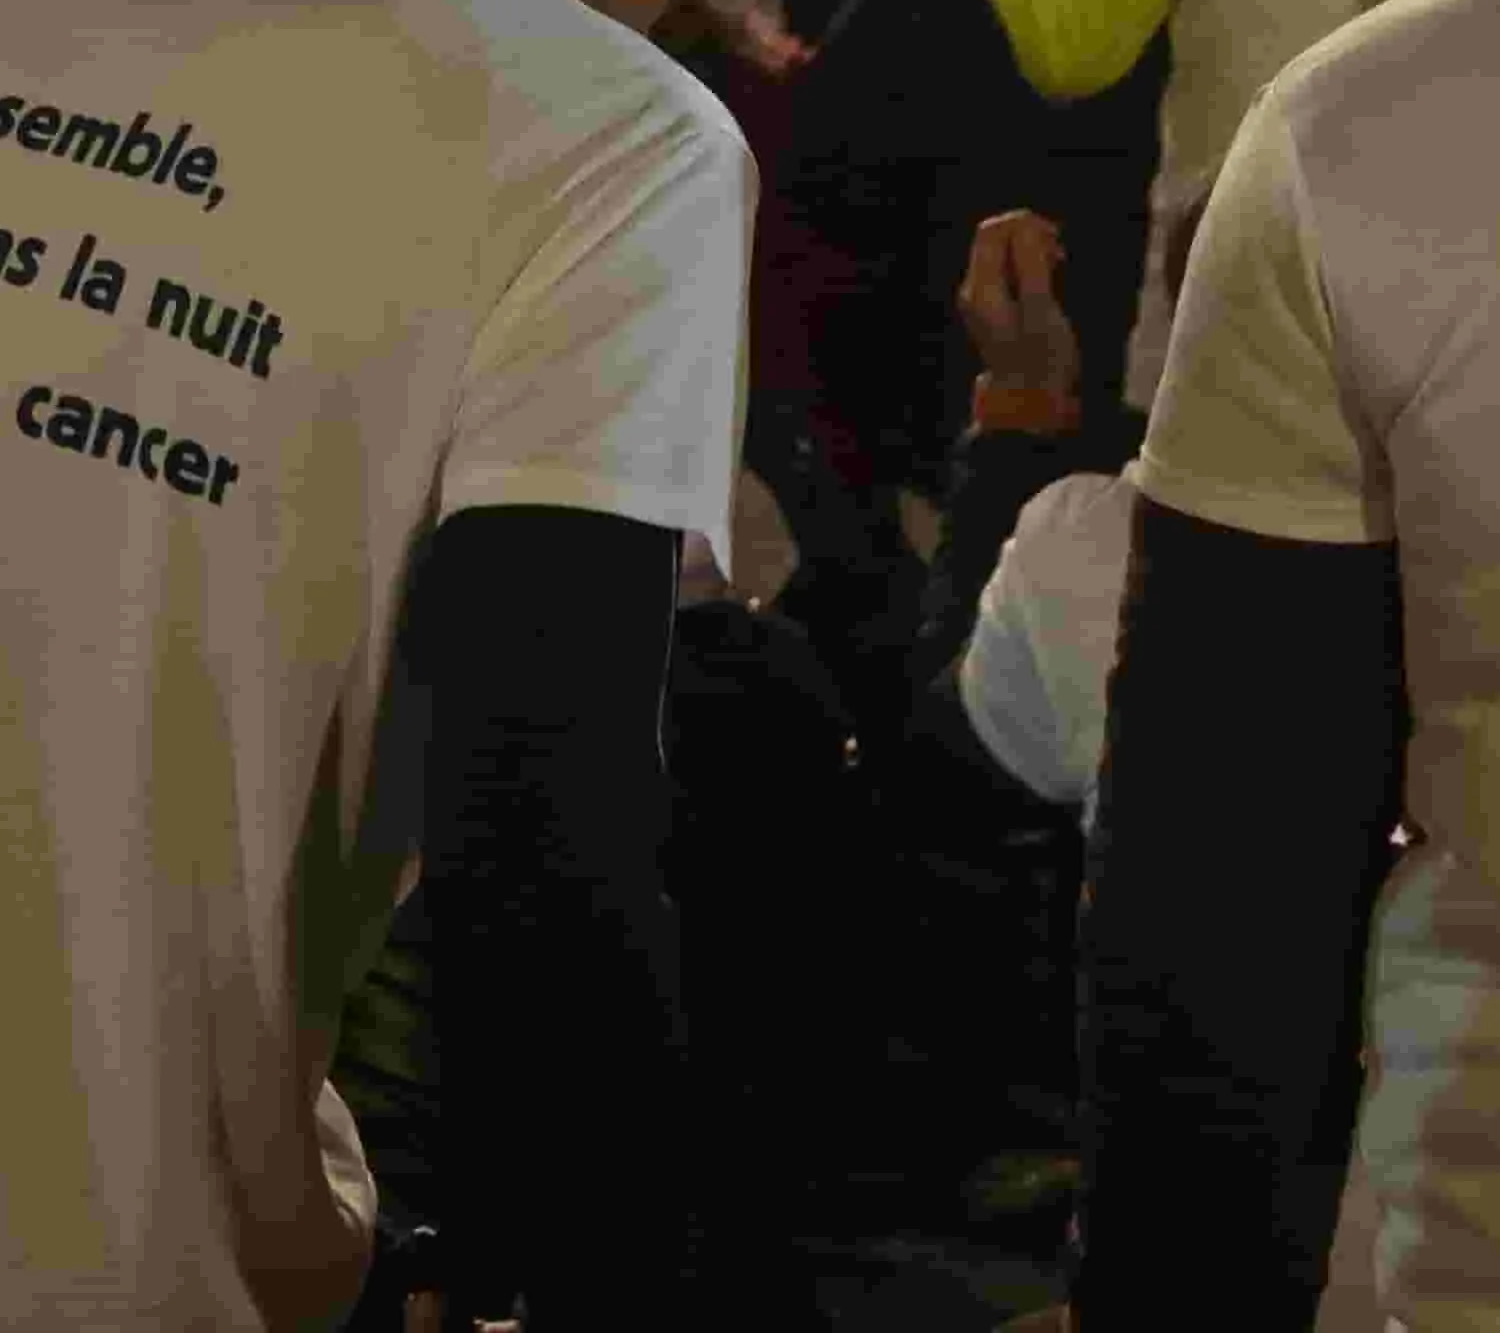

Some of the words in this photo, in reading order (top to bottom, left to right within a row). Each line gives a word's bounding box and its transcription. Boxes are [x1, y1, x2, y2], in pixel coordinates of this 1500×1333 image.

[60, 234, 127, 316] la
[145, 277, 285, 381] nuit
[15, 384, 241, 507] cancer
